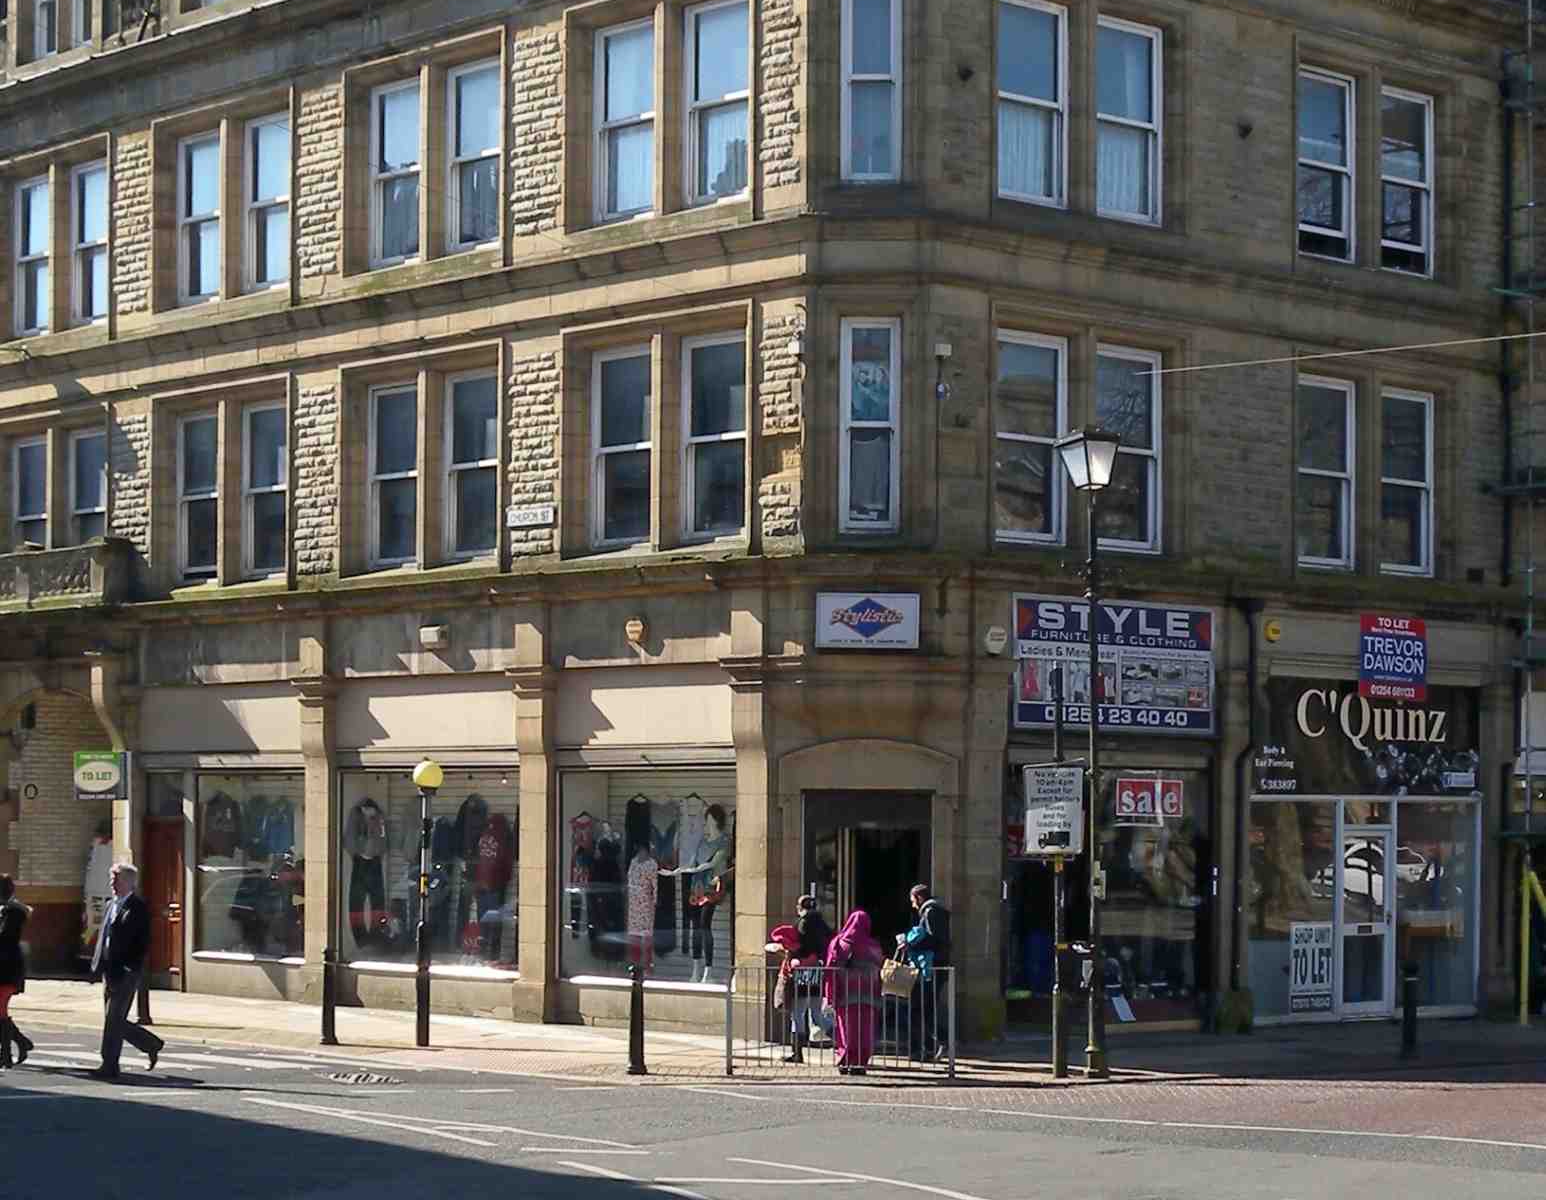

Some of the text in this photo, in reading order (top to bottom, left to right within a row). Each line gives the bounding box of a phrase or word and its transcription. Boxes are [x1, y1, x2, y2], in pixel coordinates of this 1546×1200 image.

[1037, 602, 1191, 638] STYLE
[1377, 617, 1410, 629] TO LET
[1115, 634, 1125, 644] &
[1129, 636, 1198, 649] CLOTHING
[1363, 636, 1424, 657] TREVOR
[1364, 653, 1425, 675] DAWSON
[1108, 708, 1132, 723] 23
[1136, 709, 1160, 725] 40
[1164, 711, 1188, 726] 40
[1296, 688, 1448, 751] C'Quinz
[81, 771, 112, 781] TO LET
[1121, 782, 1178, 814] sale
[1295, 927, 1313, 944] SHOP
[1293, 947, 1332, 985] TO LET
